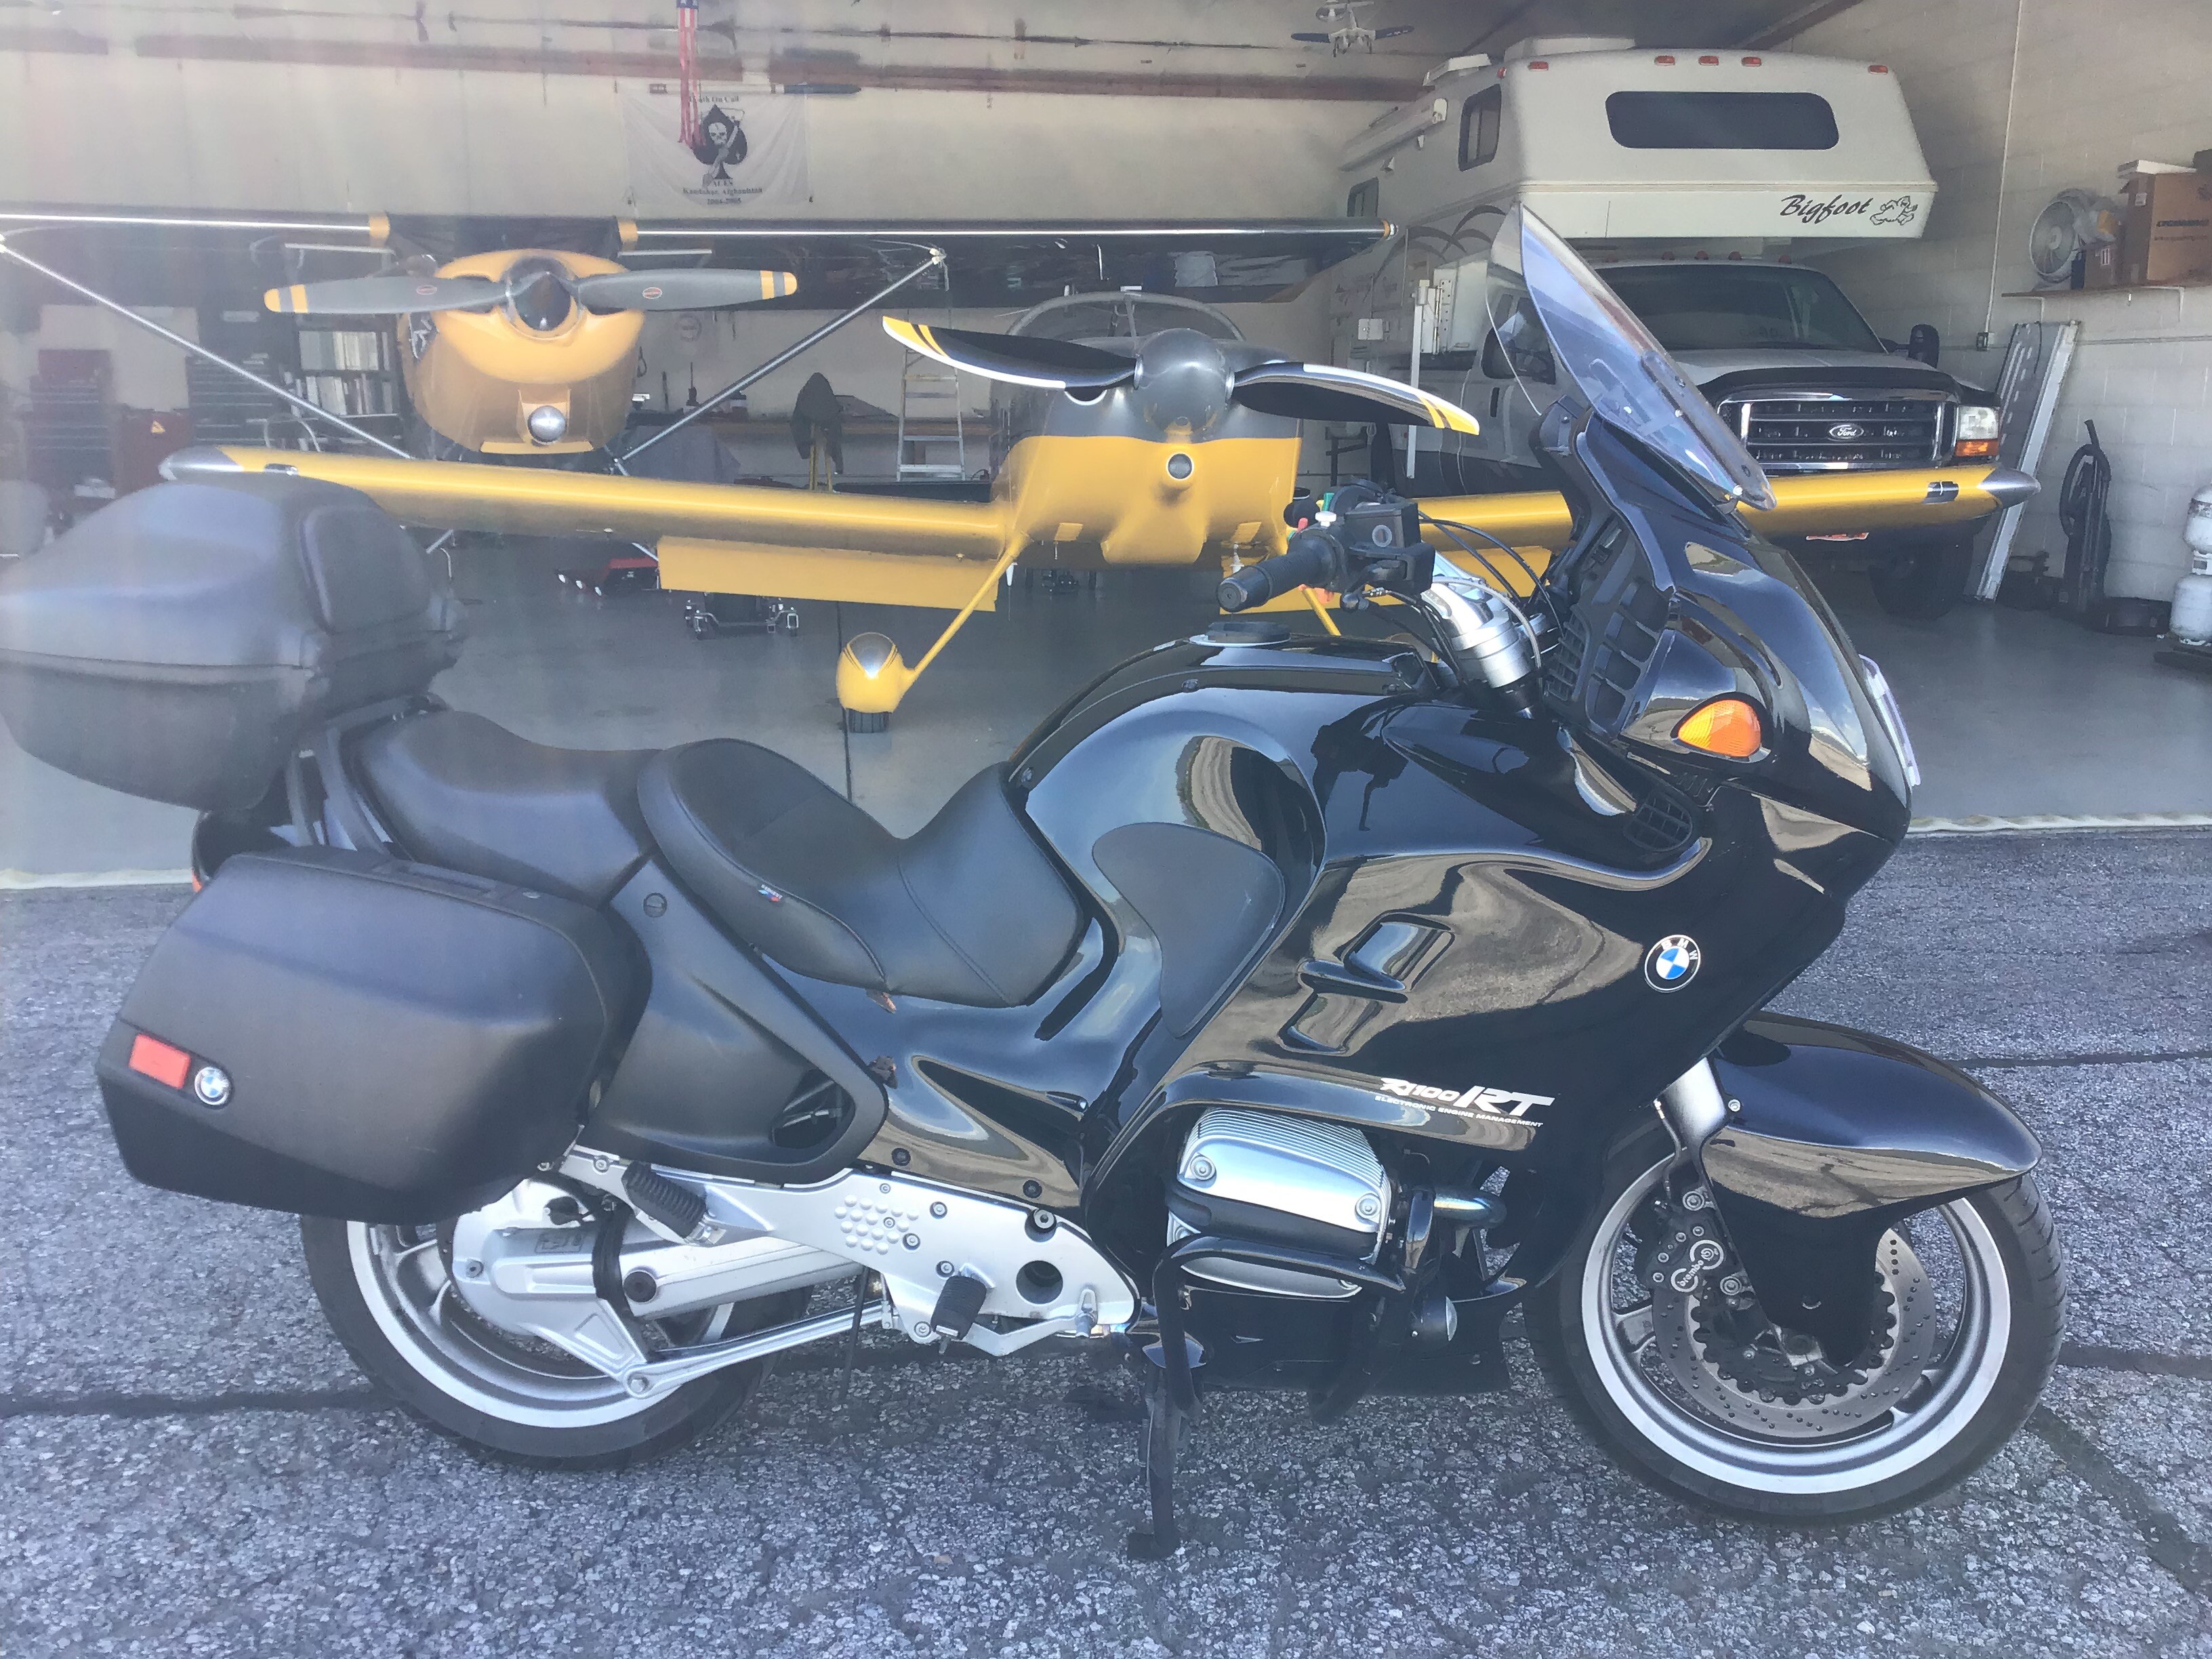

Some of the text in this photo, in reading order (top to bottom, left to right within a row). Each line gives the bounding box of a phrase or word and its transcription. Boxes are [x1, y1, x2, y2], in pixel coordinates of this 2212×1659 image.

[1780, 194, 1874, 224] Bigfoot
[1837, 427, 1858, 436] Ford
[1374, 1095, 1544, 1128] ELECTRONIC ENGINE MANAGEMENT
[1677, 1259, 1704, 1287] brembo
